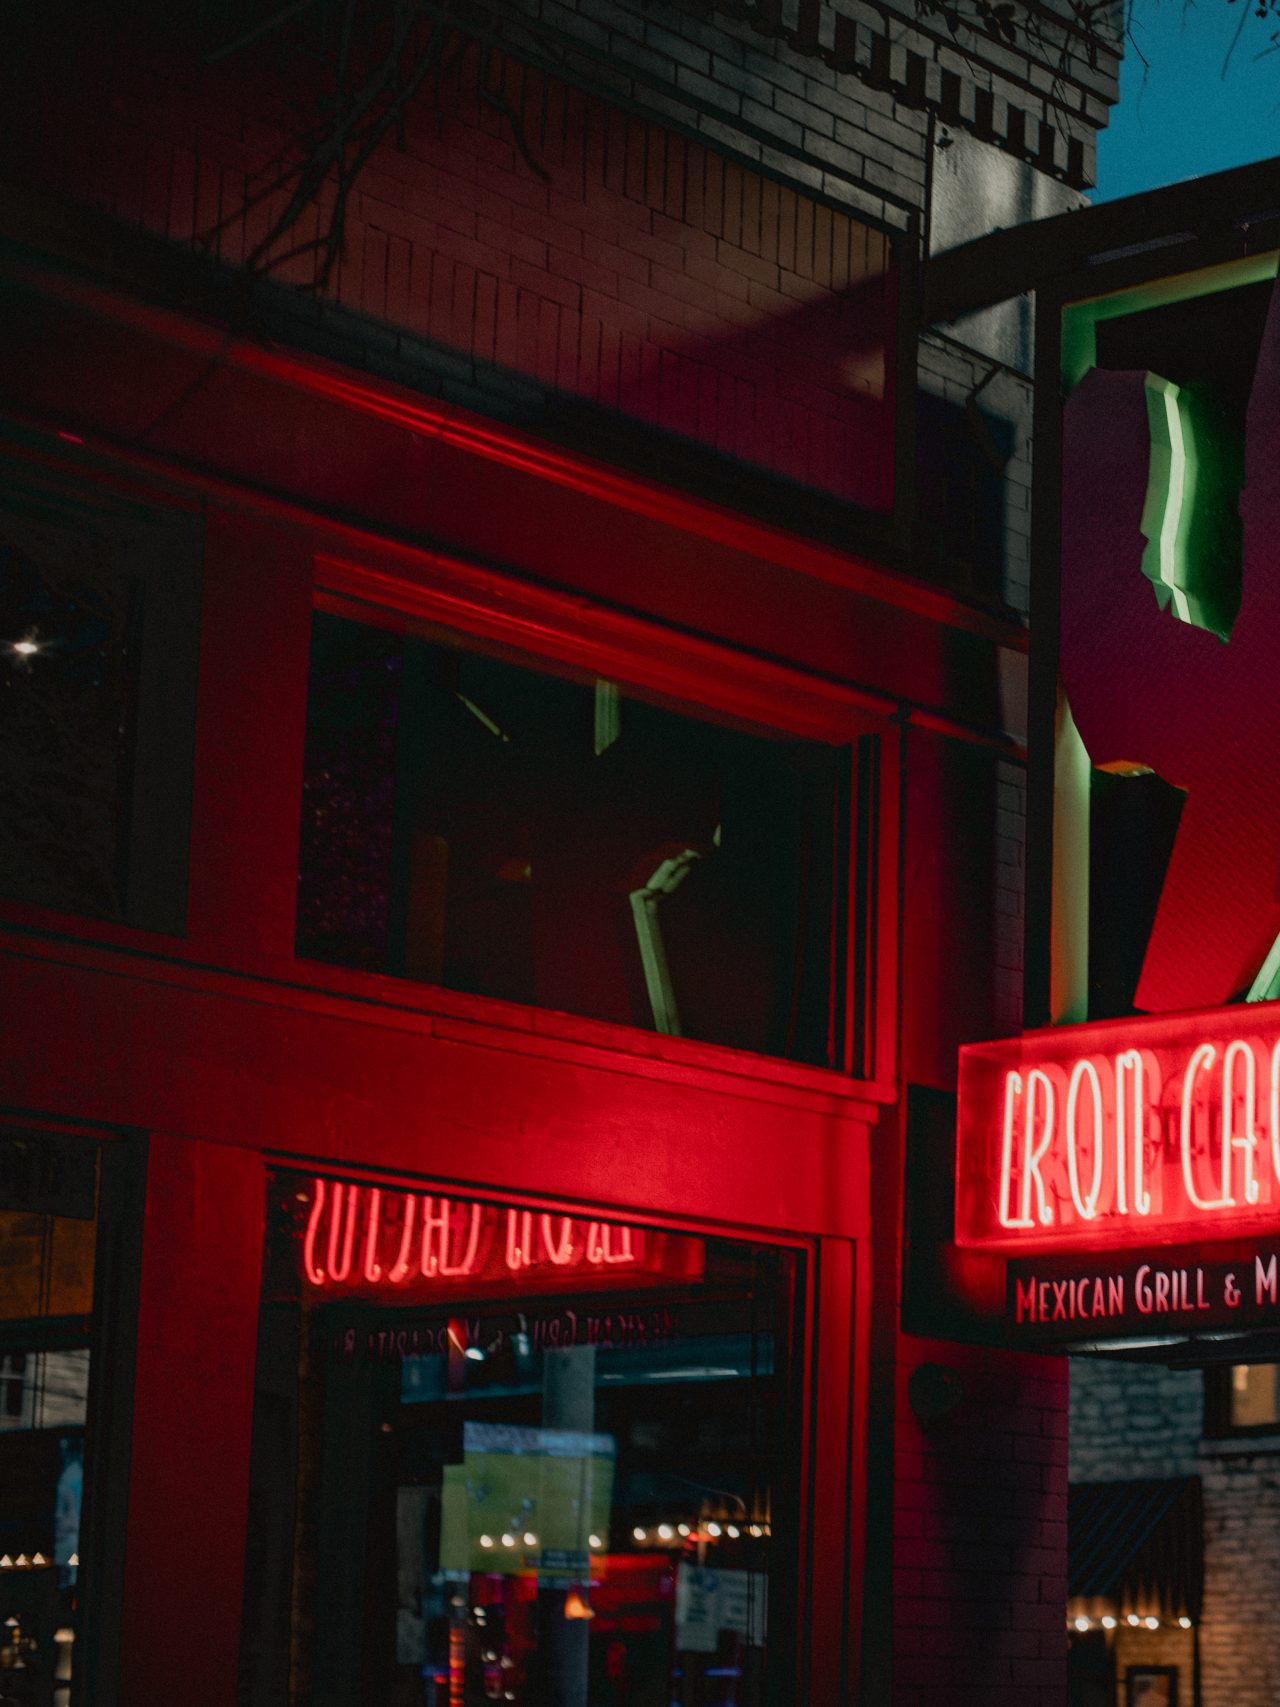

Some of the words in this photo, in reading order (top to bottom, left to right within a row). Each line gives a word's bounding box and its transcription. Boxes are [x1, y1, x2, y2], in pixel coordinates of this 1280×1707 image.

[999, 1048, 1153, 1228] IRON
[1015, 1274, 1125, 1325] MEXICAN
[1134, 1263, 1211, 1315] GRILL
[1223, 1272, 1243, 1309] &
